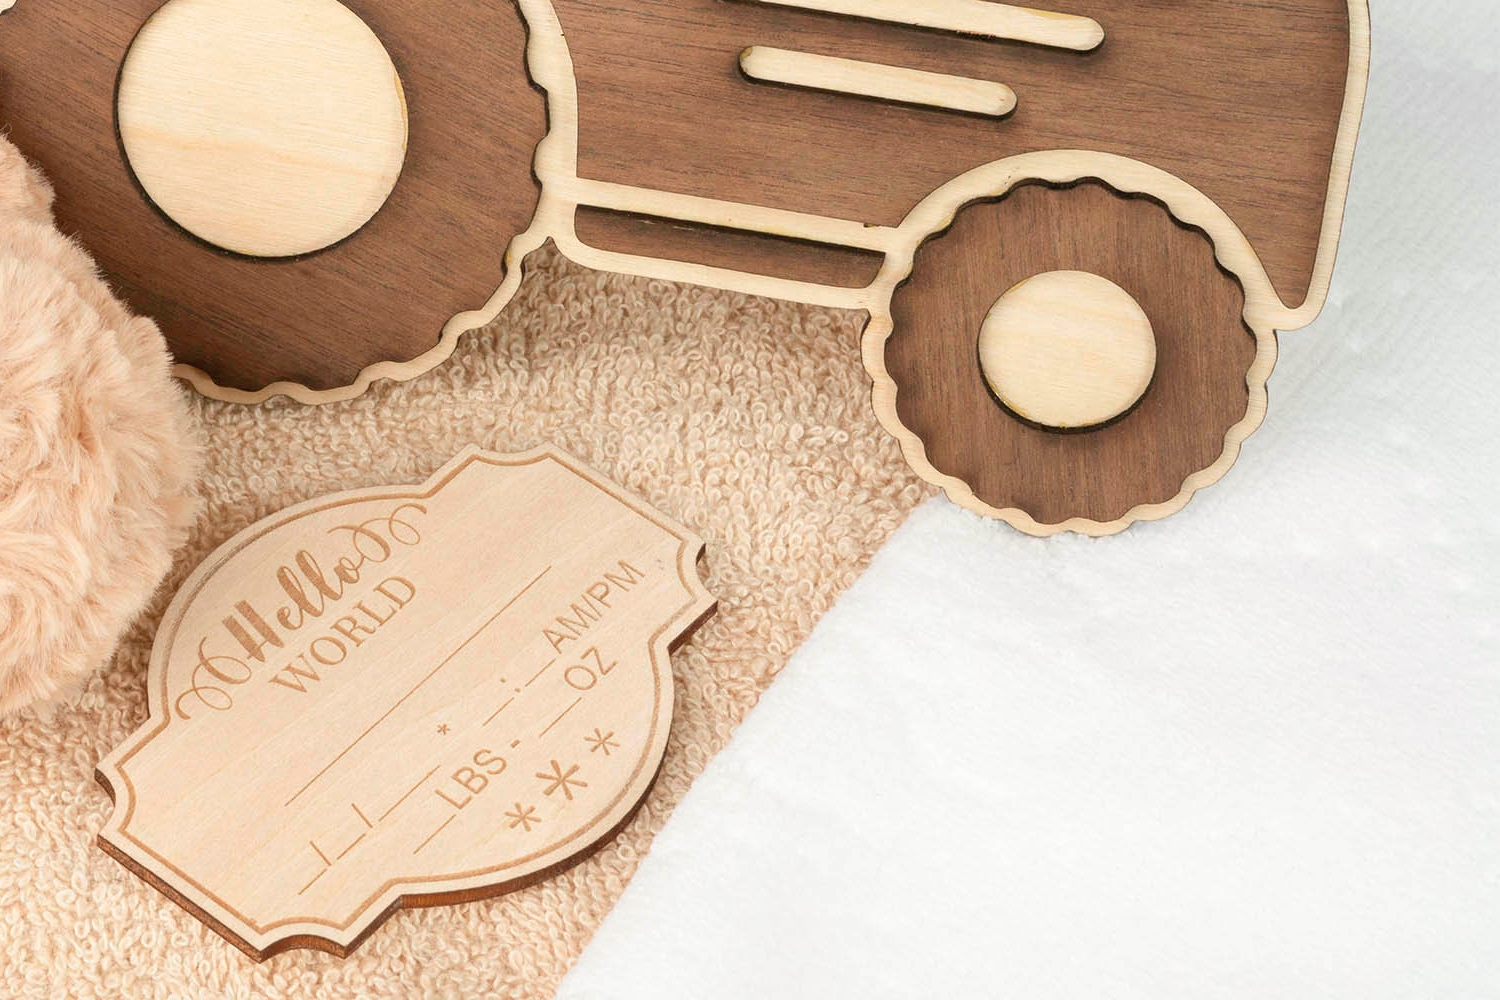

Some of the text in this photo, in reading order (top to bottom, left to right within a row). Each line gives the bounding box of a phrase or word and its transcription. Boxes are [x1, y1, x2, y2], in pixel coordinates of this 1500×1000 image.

[198, 525, 390, 685] Hello
[267, 575, 417, 693] WORLD
[542, 559, 646, 655] AM/PM
[434, 645, 619, 810] LBS OZ
